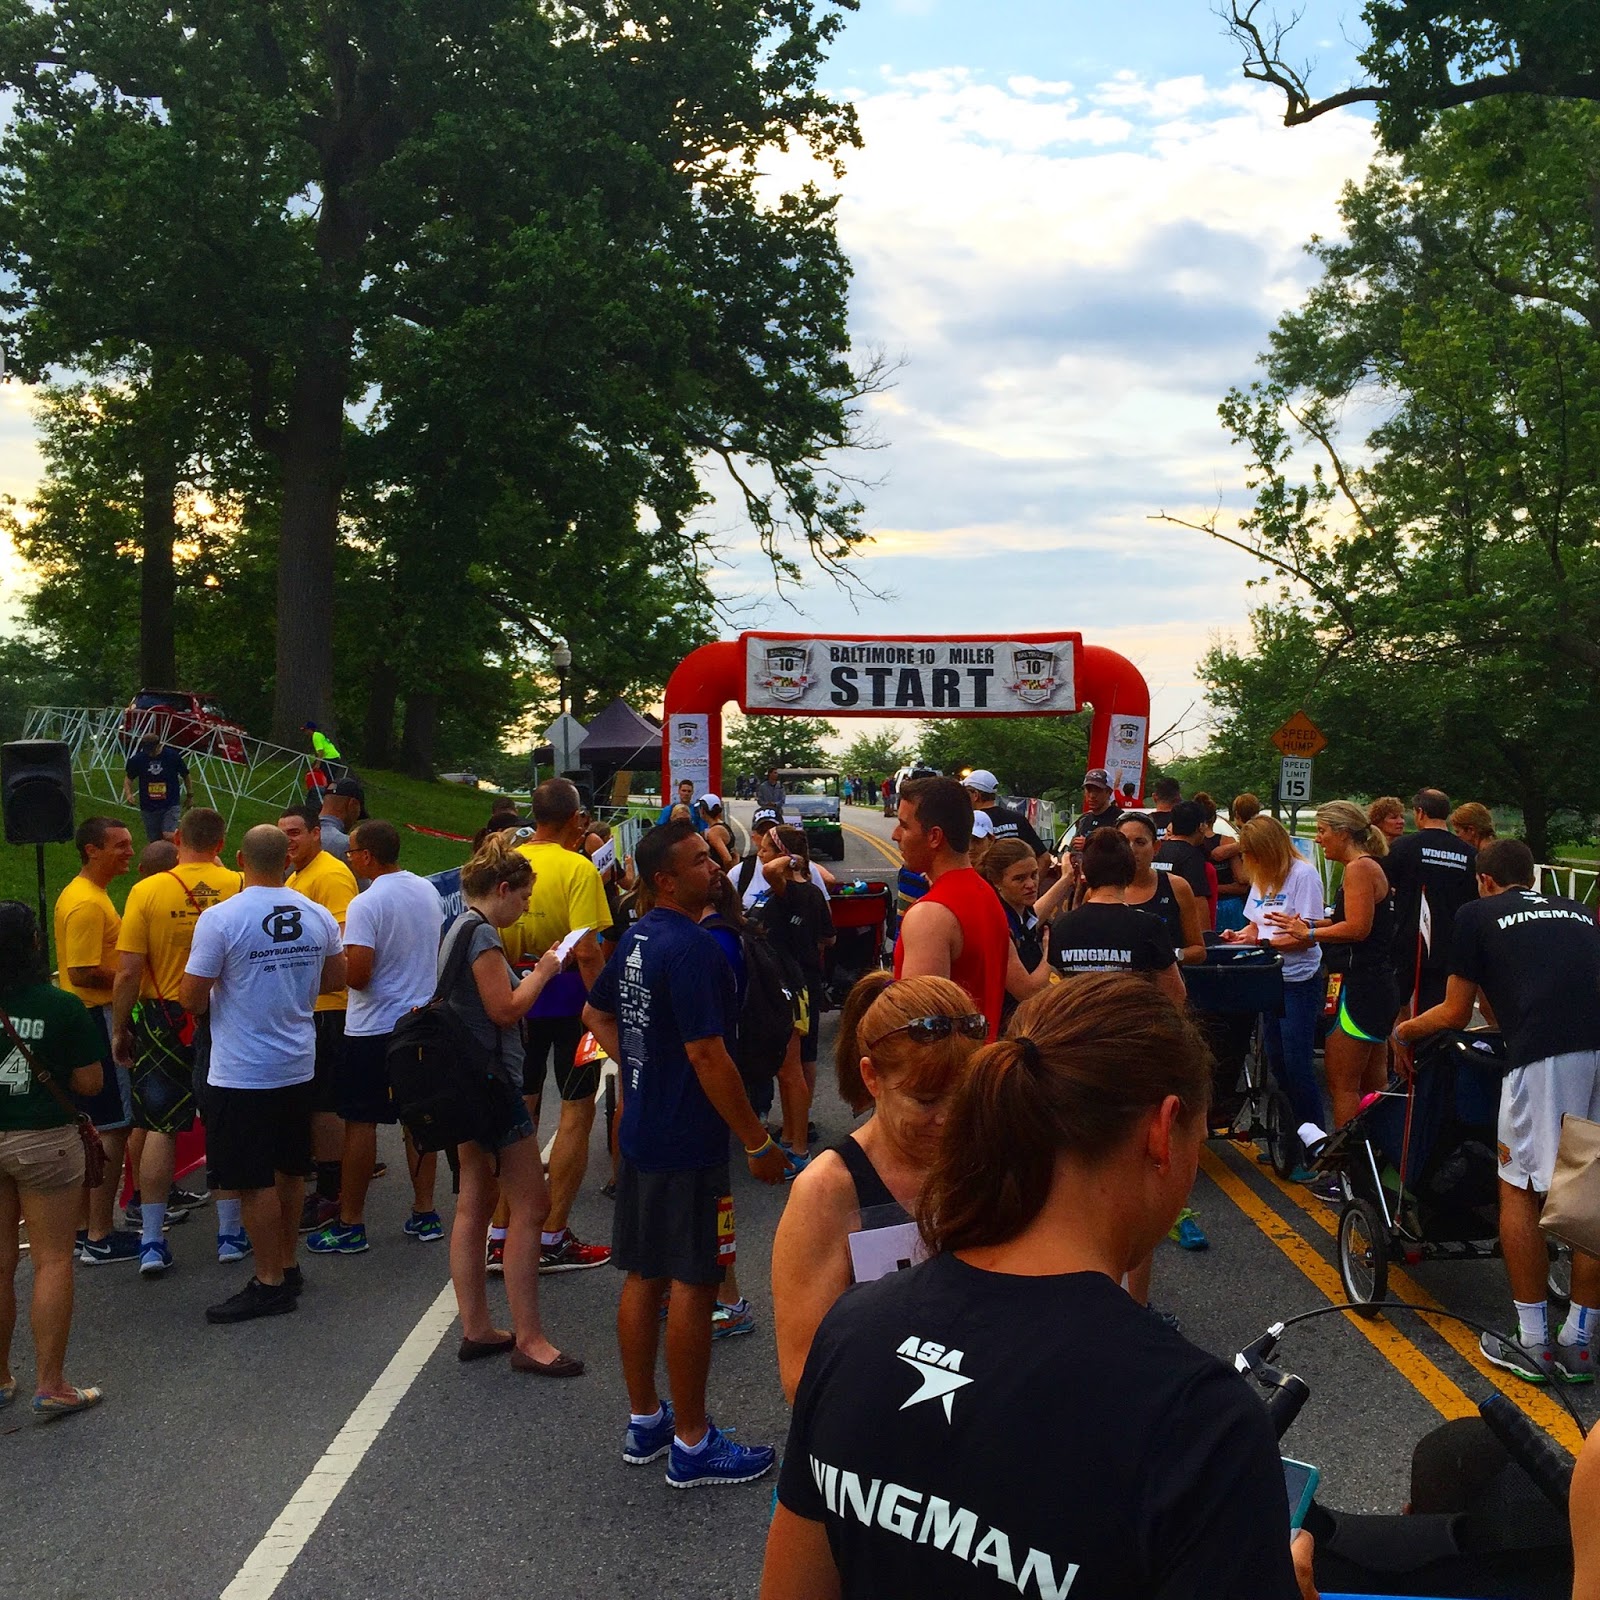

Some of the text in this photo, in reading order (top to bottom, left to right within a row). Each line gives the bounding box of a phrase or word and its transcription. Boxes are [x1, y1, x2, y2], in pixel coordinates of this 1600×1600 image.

[830, 647, 994, 664] BALTIMORE 10 MILER
[779, 658, 794, 671] 10
[1026, 660, 1041, 674] 10
[830, 666, 994, 707] START
[684, 728, 692, 736] 10
[1126, 730, 1133, 738] 10
[1282, 729, 1317, 740] SPEED
[1283, 741, 1314, 752] HUMP
[1284, 761, 1311, 769] SPEED
[1286, 770, 1307, 778] LIMIT
[1286, 780, 1305, 797] 15
[598, 850, 613, 870] JAKE
[1421, 847, 1468, 863] WINGMAN
[1497, 909, 1594, 930] WINGMAN
[1061, 949, 1132, 963] WINGMAN
[896, 1335, 964, 1372] ASA
[809, 1453, 1080, 1600] WINGMAN
